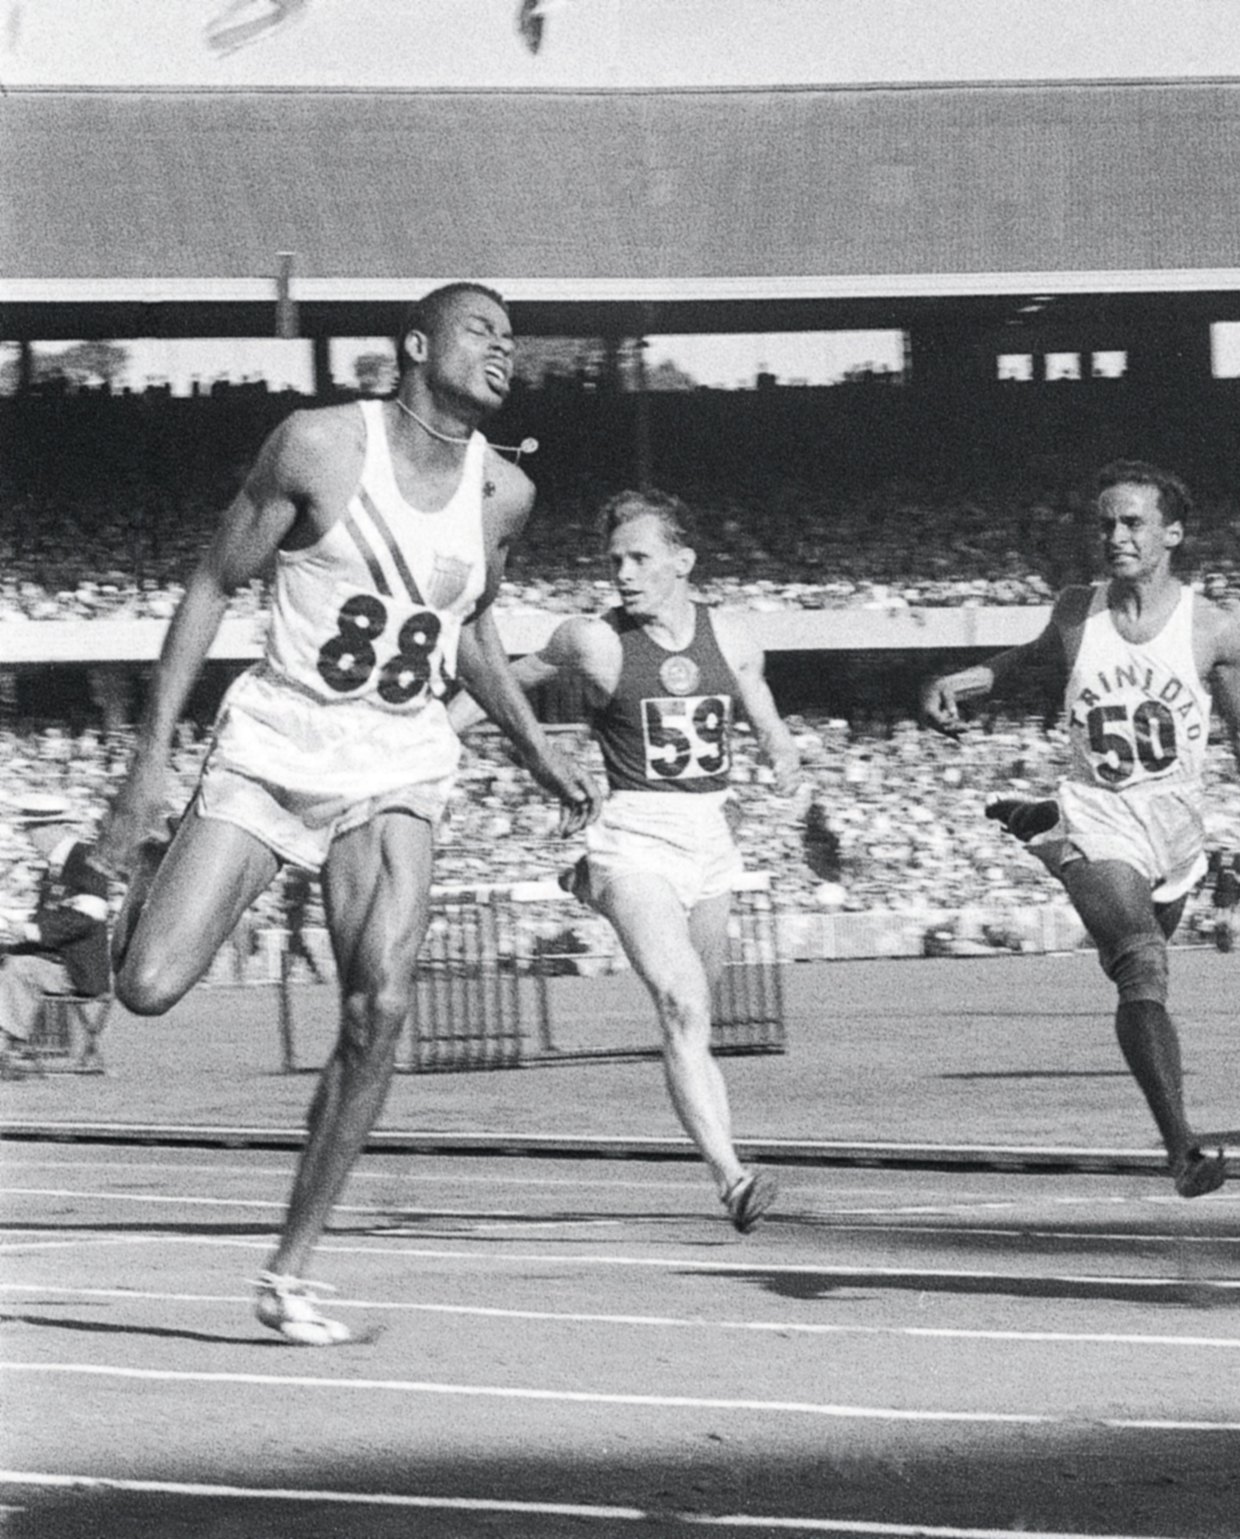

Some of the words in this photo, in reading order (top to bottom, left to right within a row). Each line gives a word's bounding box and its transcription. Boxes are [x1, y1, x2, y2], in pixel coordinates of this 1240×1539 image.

[316, 594, 442, 704] 88
[645, 697, 725, 777] 59
[1070, 665, 1200, 740] TRINIDAD
[1087, 700, 1178, 783] 50
